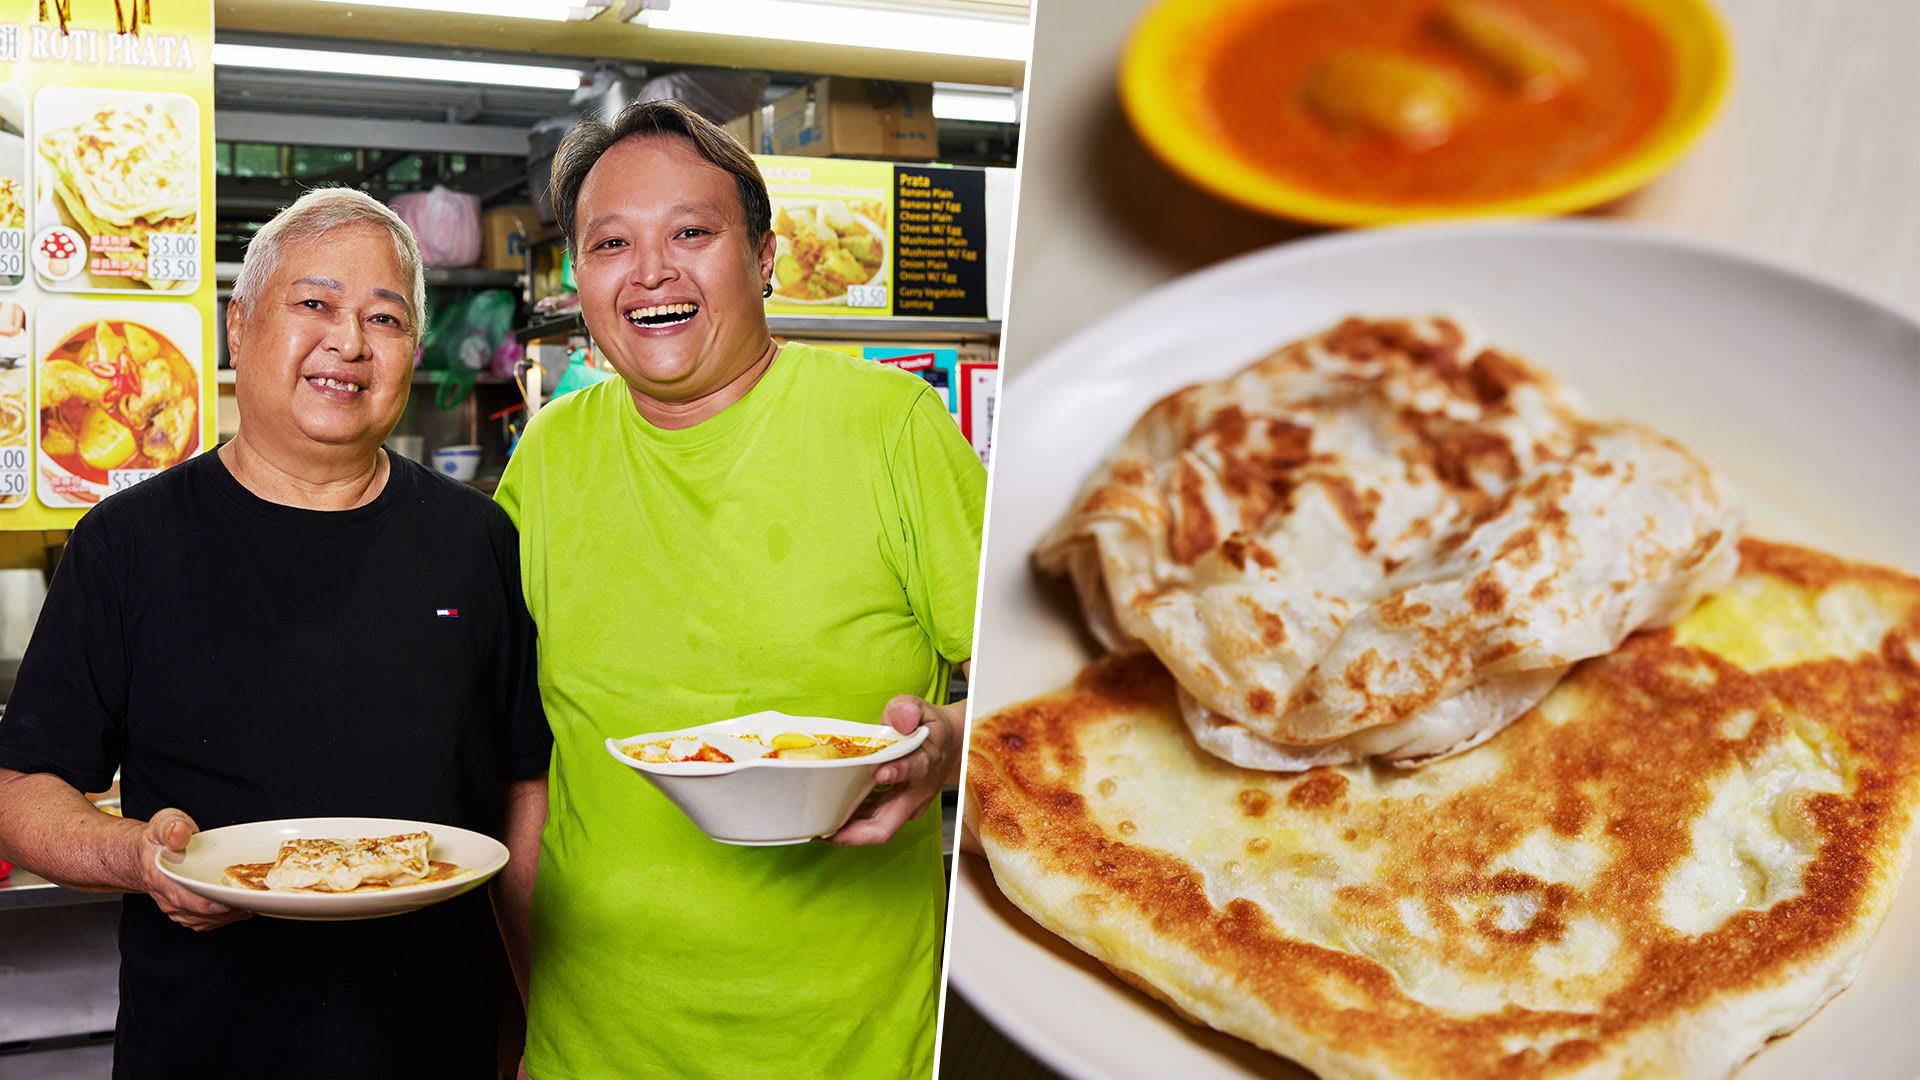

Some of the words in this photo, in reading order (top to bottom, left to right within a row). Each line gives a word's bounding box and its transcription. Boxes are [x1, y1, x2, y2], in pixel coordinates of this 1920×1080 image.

[31, 26, 98, 62] ROTI
[105, 31, 195, 69] PRATA
[900, 173, 931, 188] Prata
[900, 187, 932, 198] Banana
[932, 188, 954, 199] Plain
[900, 199, 932, 210] Banana
[946, 201, 962, 213] Egg
[900, 211, 931, 221] Cheese
[932, 212, 953, 222] Plain
[900, 223, 931, 233] Cheese
[947, 225, 962, 237] Egg
[151, 236, 196, 255] $3.00
[900, 236, 945, 246] Mushroom
[946, 237, 968, 247] Plain
[900, 247, 946, 258] Mushroom
[961, 249, 977, 262] Egg
[151, 258, 197, 279] $3.50
[899, 259, 926, 269] Onion
[927, 260, 948, 269] Plain
[899, 271, 926, 281] Onion
[850, 287, 886, 306] $3.50
[899, 286, 923, 299] Curry
